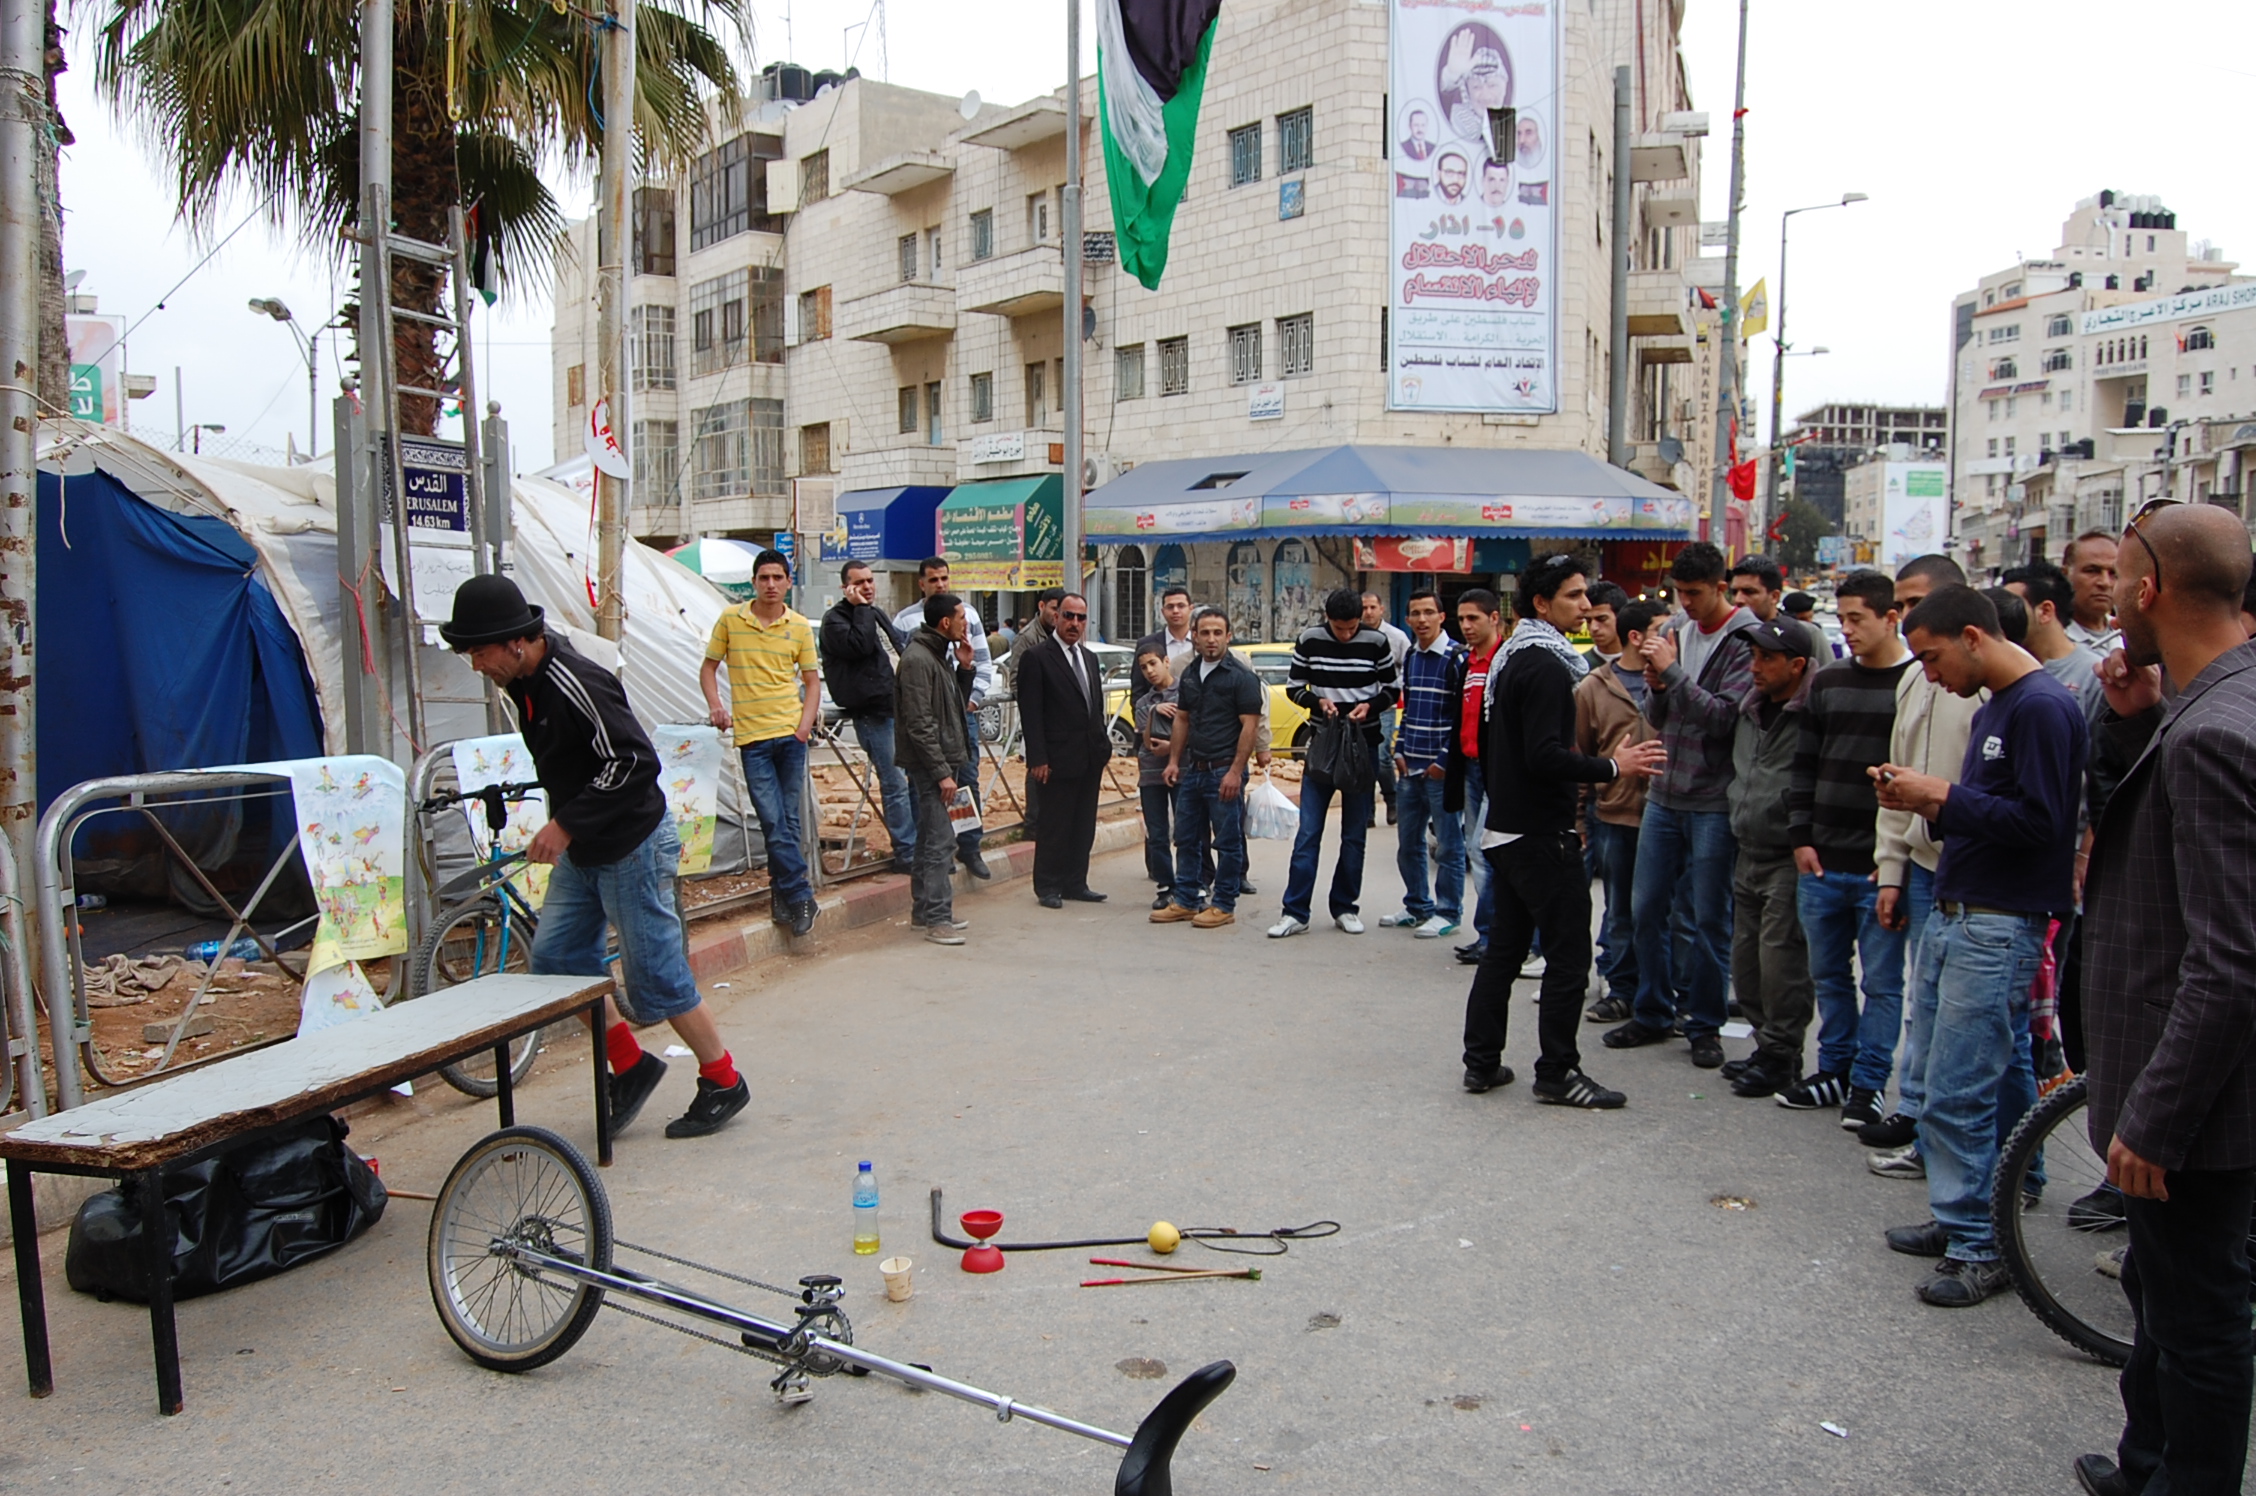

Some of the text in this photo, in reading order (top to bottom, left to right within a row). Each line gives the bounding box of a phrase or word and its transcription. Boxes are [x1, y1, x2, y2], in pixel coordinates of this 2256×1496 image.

[1403, 241, 1487, 270] الاحتلال
[1404, 272, 1484, 304] الانقسام
[1407, 312, 1438, 326] طريق
[1441, 314, 1461, 326] على
[1464, 314, 1508, 327] فلسطين
[1400, 353, 1443, 369] فلسطين
[1446, 355, 1482, 371] لشباب
[1484, 356, 1512, 372] العام
[409, 474, 447, 493] القدس
[406, 496, 458, 513] ERUSALEM
[411, 515, 451, 529] 14.63 km
